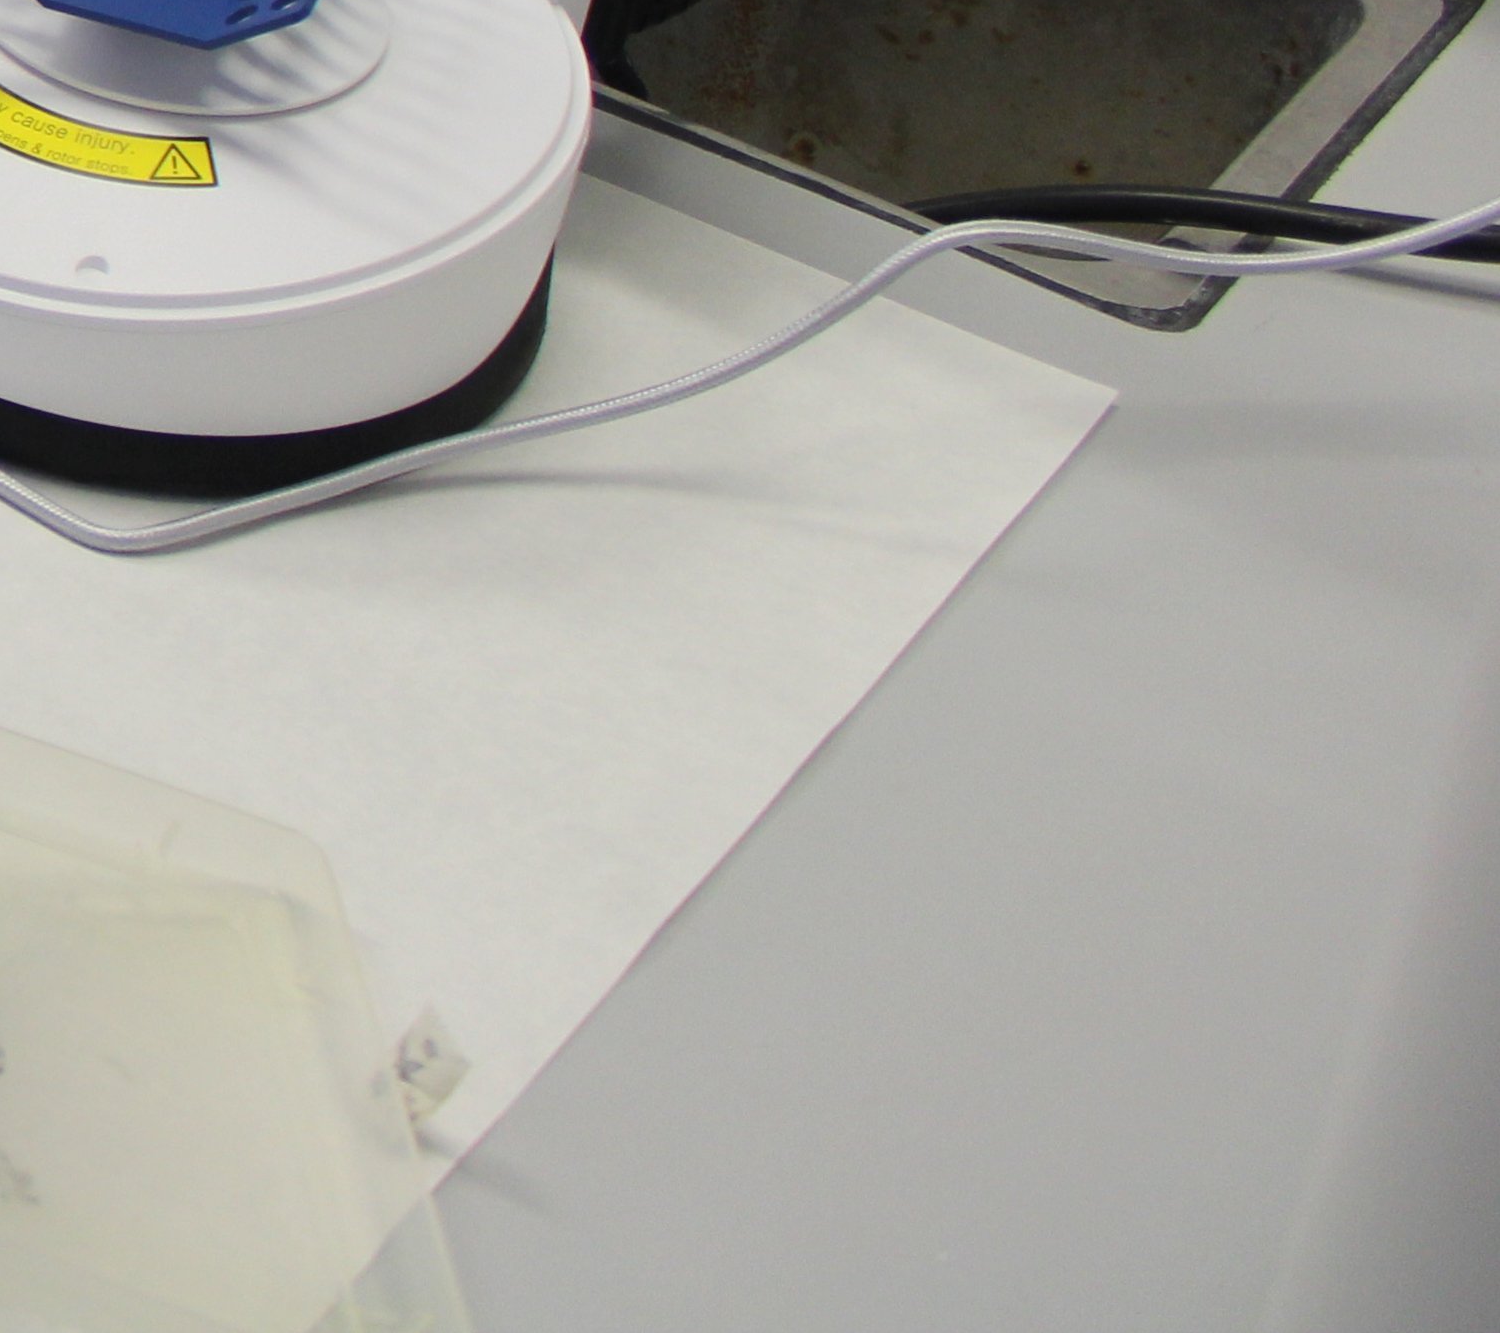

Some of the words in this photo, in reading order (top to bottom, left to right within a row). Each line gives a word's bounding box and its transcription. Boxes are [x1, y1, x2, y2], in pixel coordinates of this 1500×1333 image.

[10, 110, 68, 139] cause
[75, 128, 136, 156] injury.
[31, 142, 43, 155] &
[46, 149, 83, 166] rotor
